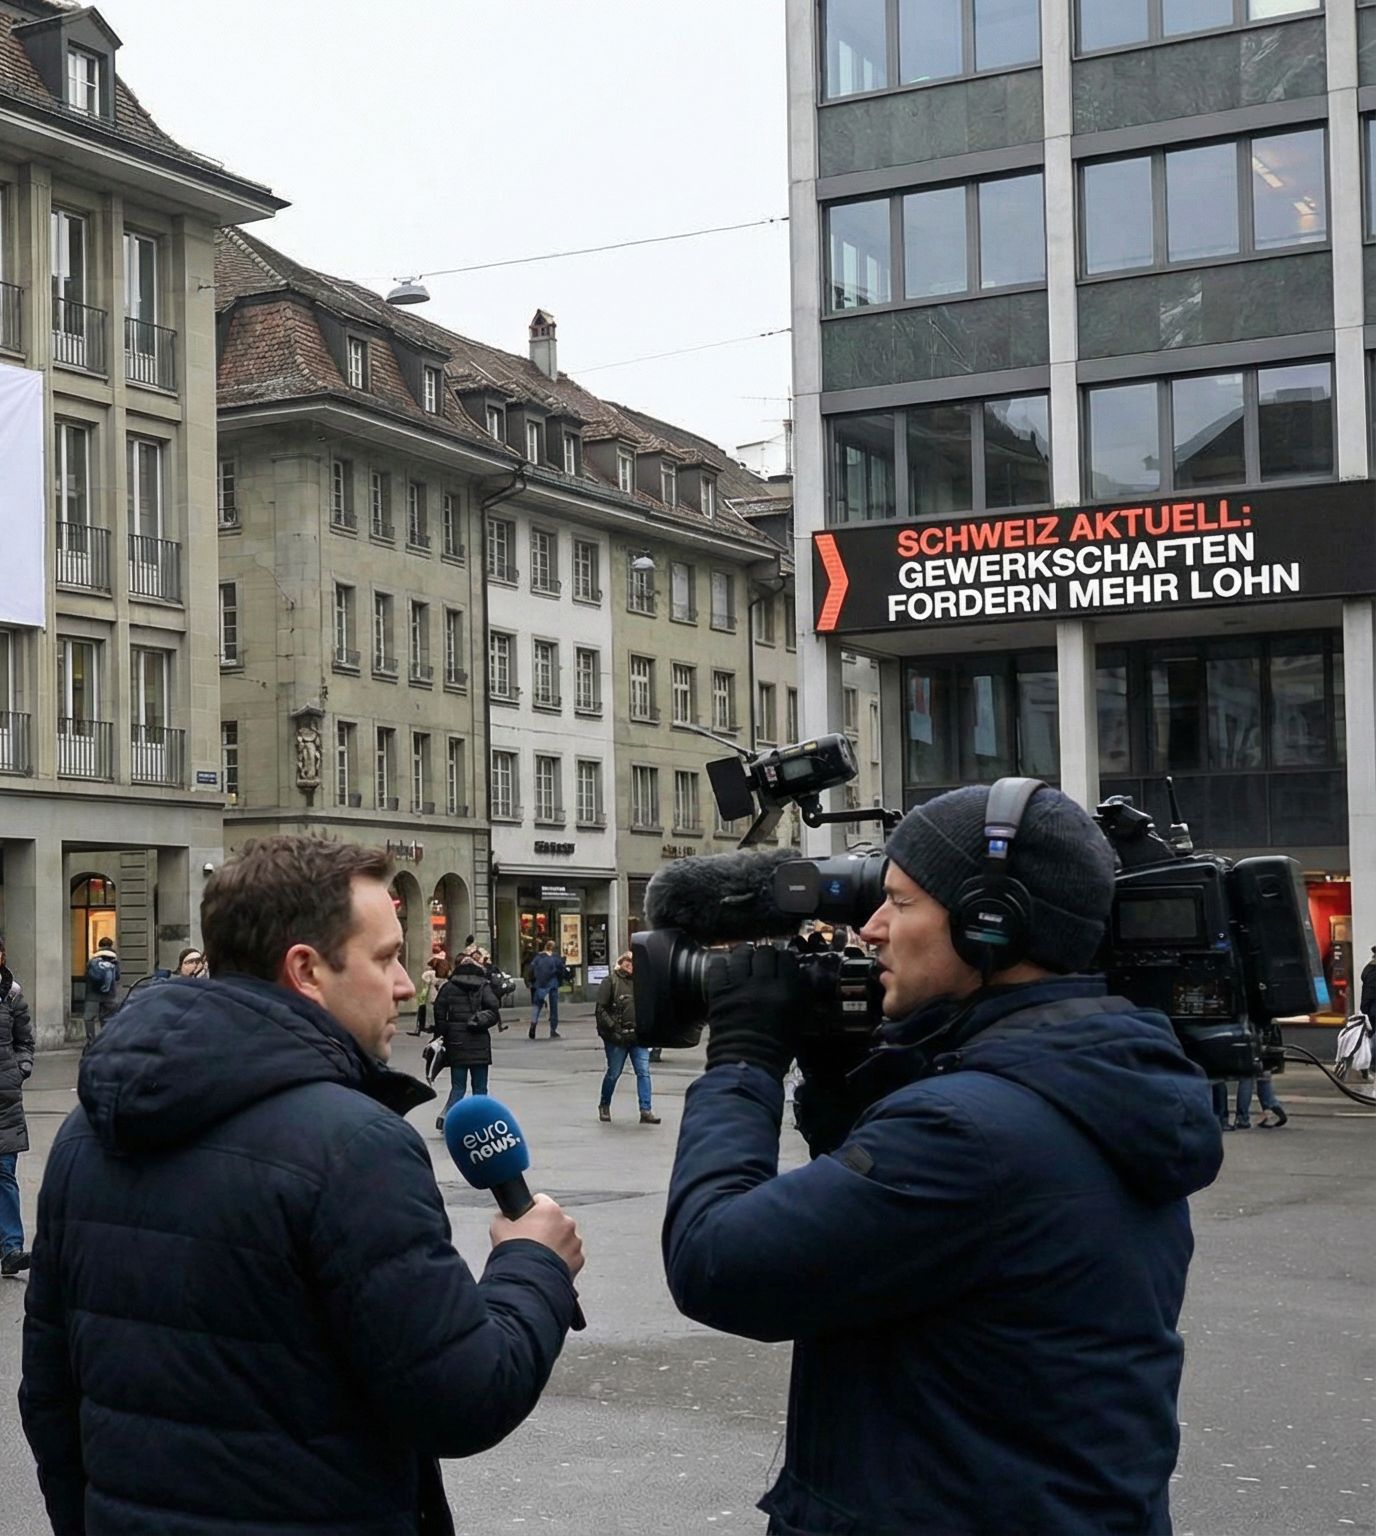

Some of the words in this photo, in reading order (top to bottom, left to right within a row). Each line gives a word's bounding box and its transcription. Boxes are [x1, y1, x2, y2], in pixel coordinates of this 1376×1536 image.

[897, 516, 1060, 557] SCHWEIZ
[1069, 499, 1252, 542] AKTUELL:
[898, 532, 1254, 589] GEWERKSCHAFTEN
[888, 582, 1058, 622] FORDERN
[1069, 572, 1178, 608] MEHR
[1190, 562, 1301, 599] LOHN
[463, 1120, 508, 1149] euro
[469, 1133, 521, 1165] news.
